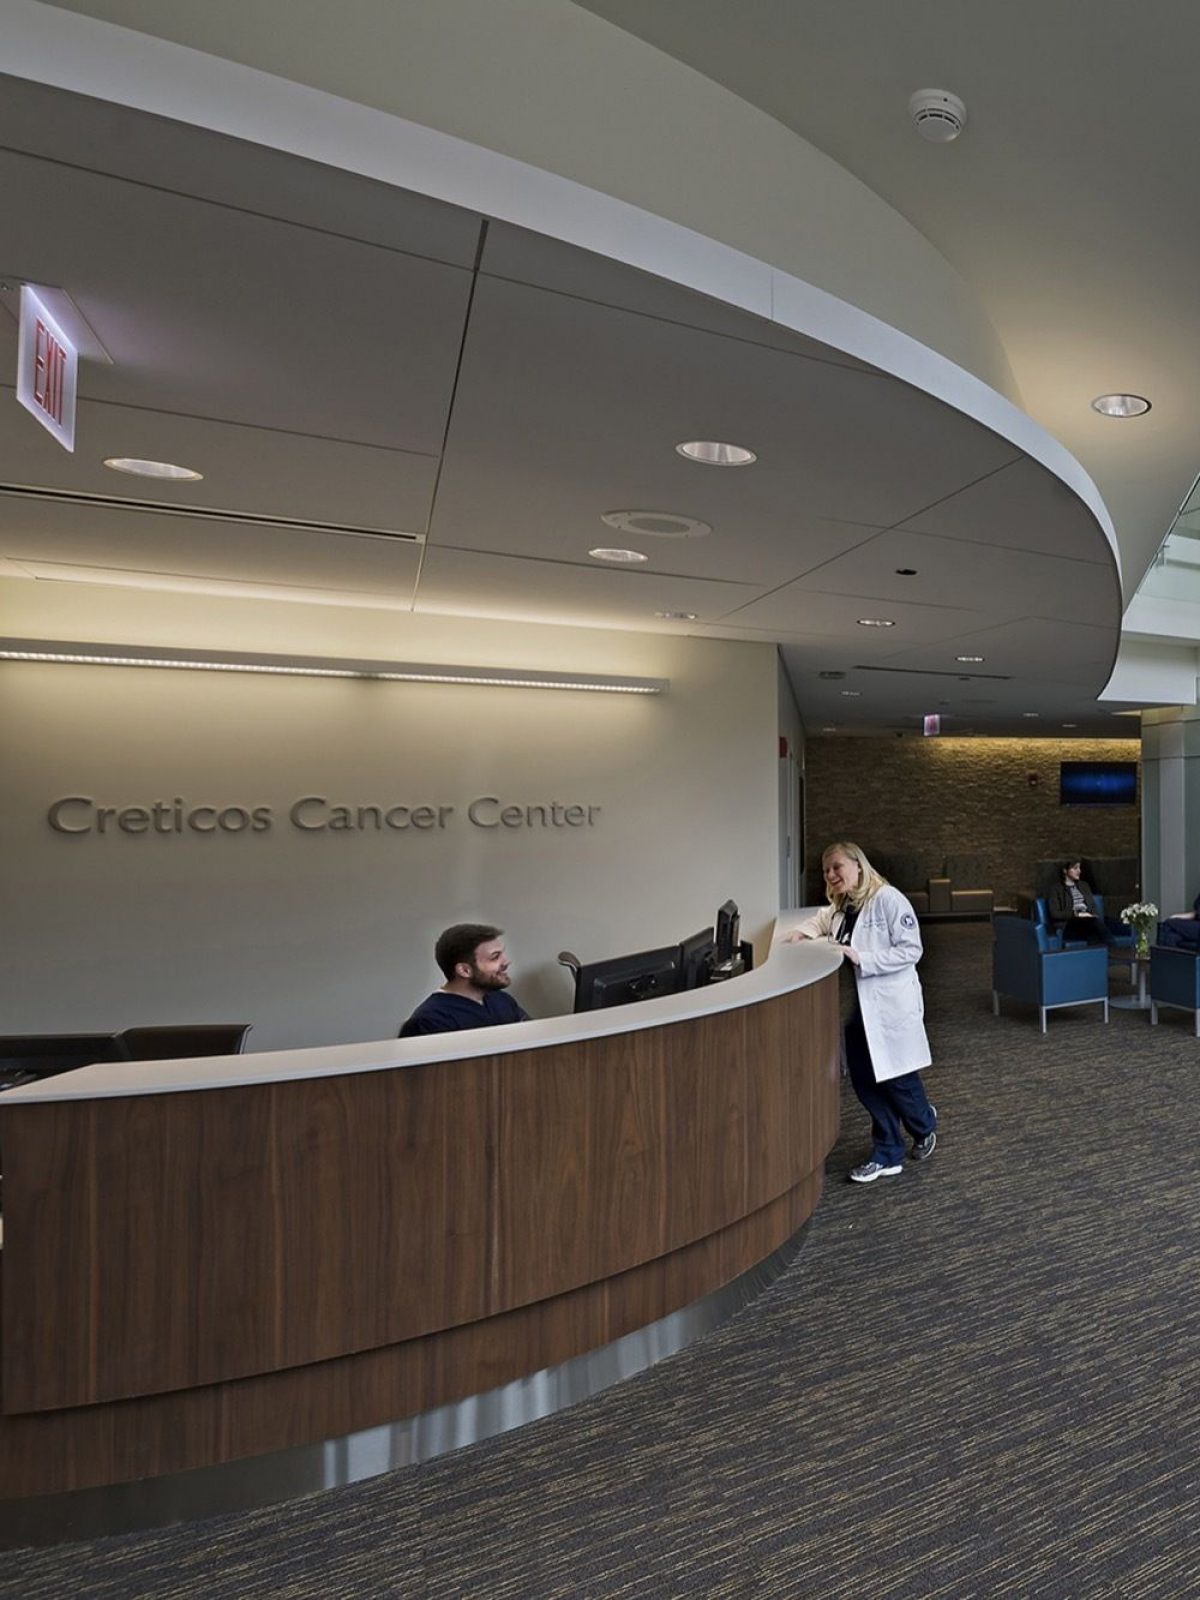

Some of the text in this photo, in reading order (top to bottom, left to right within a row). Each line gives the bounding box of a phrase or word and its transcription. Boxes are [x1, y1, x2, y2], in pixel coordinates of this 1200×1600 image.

[34, 318, 67, 426] EXIT
[47, 797, 601, 834] Creticos Cancer Center
